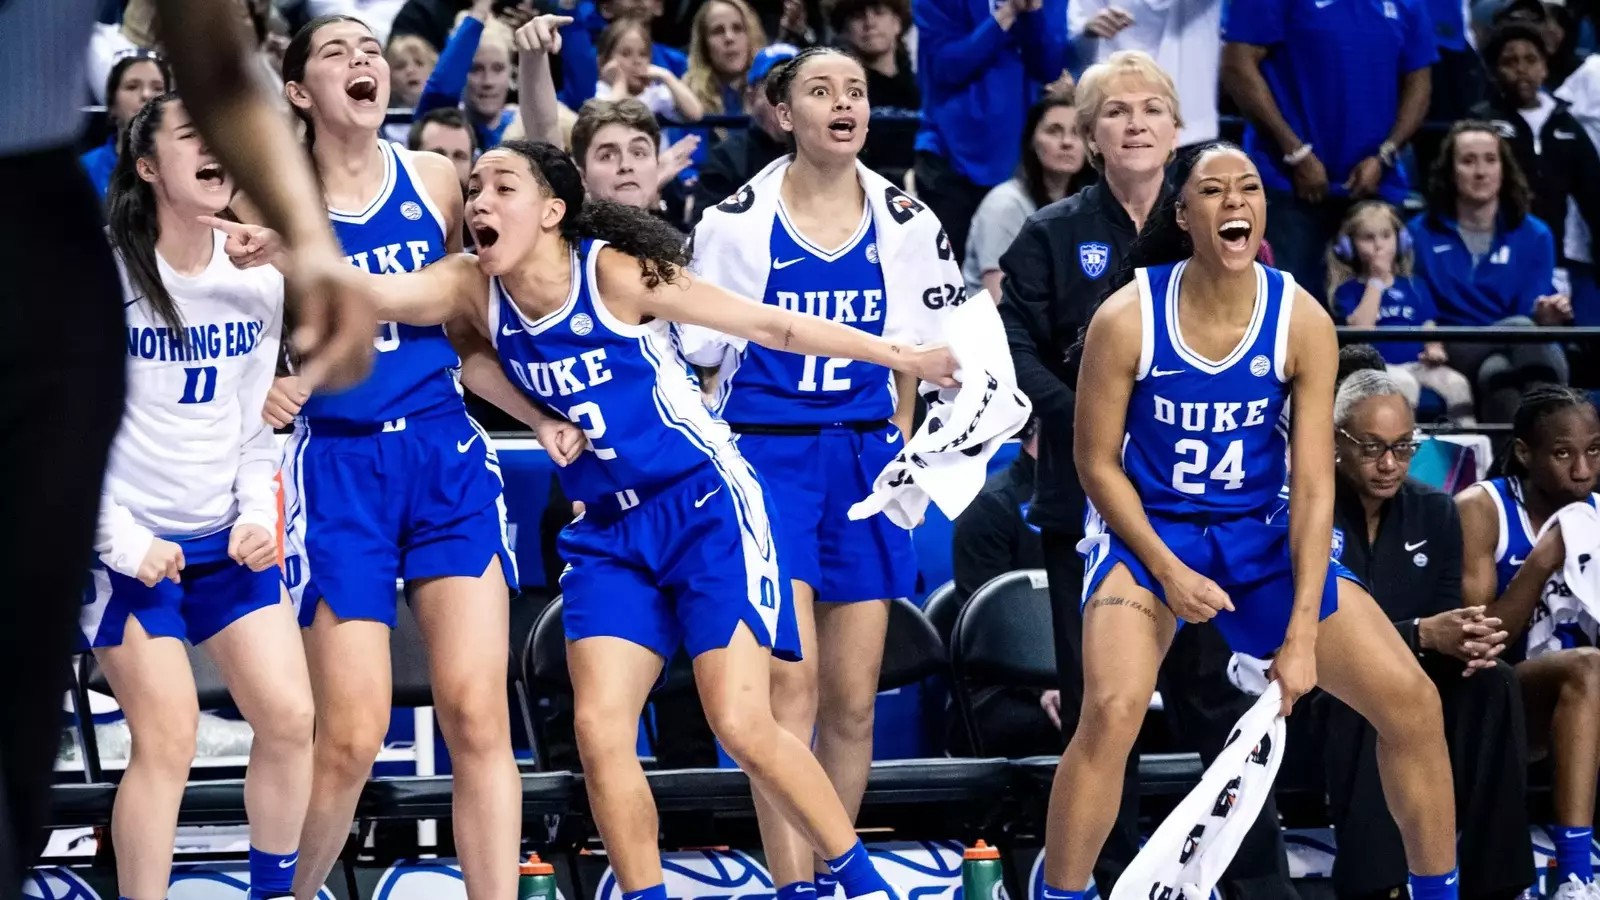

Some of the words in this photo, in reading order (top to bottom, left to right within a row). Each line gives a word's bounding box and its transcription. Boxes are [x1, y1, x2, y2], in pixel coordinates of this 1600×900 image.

[126, 324, 221, 362] NOTHING
[509, 348, 613, 397] DUKE
[1154, 395, 1269, 433] DUKE
[1172, 438, 1245, 494] 24
